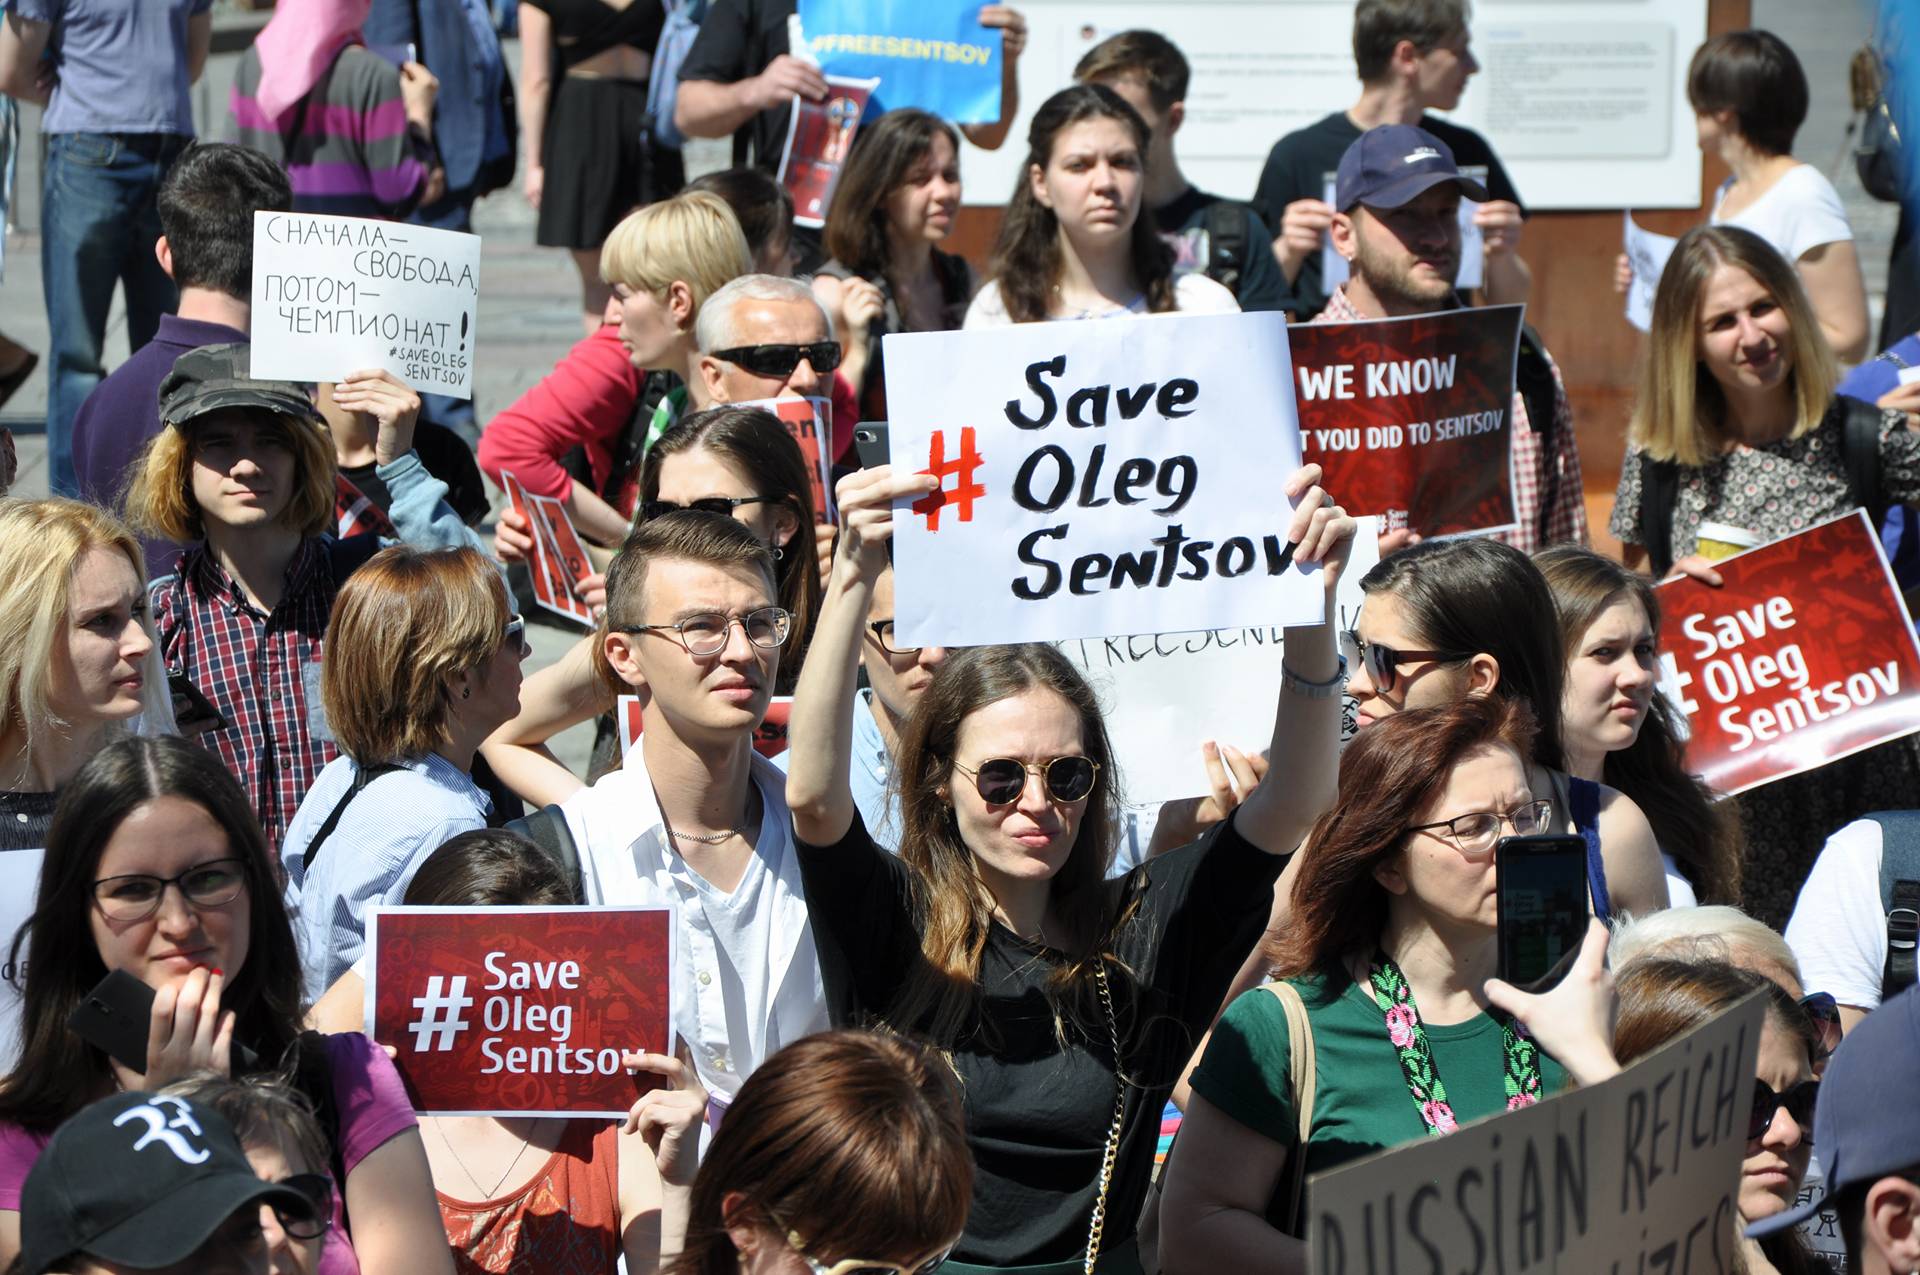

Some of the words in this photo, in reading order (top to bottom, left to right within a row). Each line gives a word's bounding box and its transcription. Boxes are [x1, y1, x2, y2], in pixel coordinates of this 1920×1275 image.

[353, 250, 478, 296] СВОБОДА,
[389, 345, 467, 369] #SAVEOLEG
[405, 363, 465, 386] SENTSOV
[1298, 364, 1356, 401] WE
[1366, 354, 1457, 398] KNOW
[1003, 354, 1200, 431] Save
[1315, 428, 1361, 452] YOU
[1366, 425, 1404, 450] DID
[1408, 421, 1431, 446] TO
[1435, 409, 1504, 442] SENTSOV
[1682, 595, 1797, 661] Save
[1703, 643, 1810, 704] Oleg
[1718, 660, 1901, 752] Sentsov
[484, 951, 580, 991] Save
[483, 995, 573, 1042] Oleg
